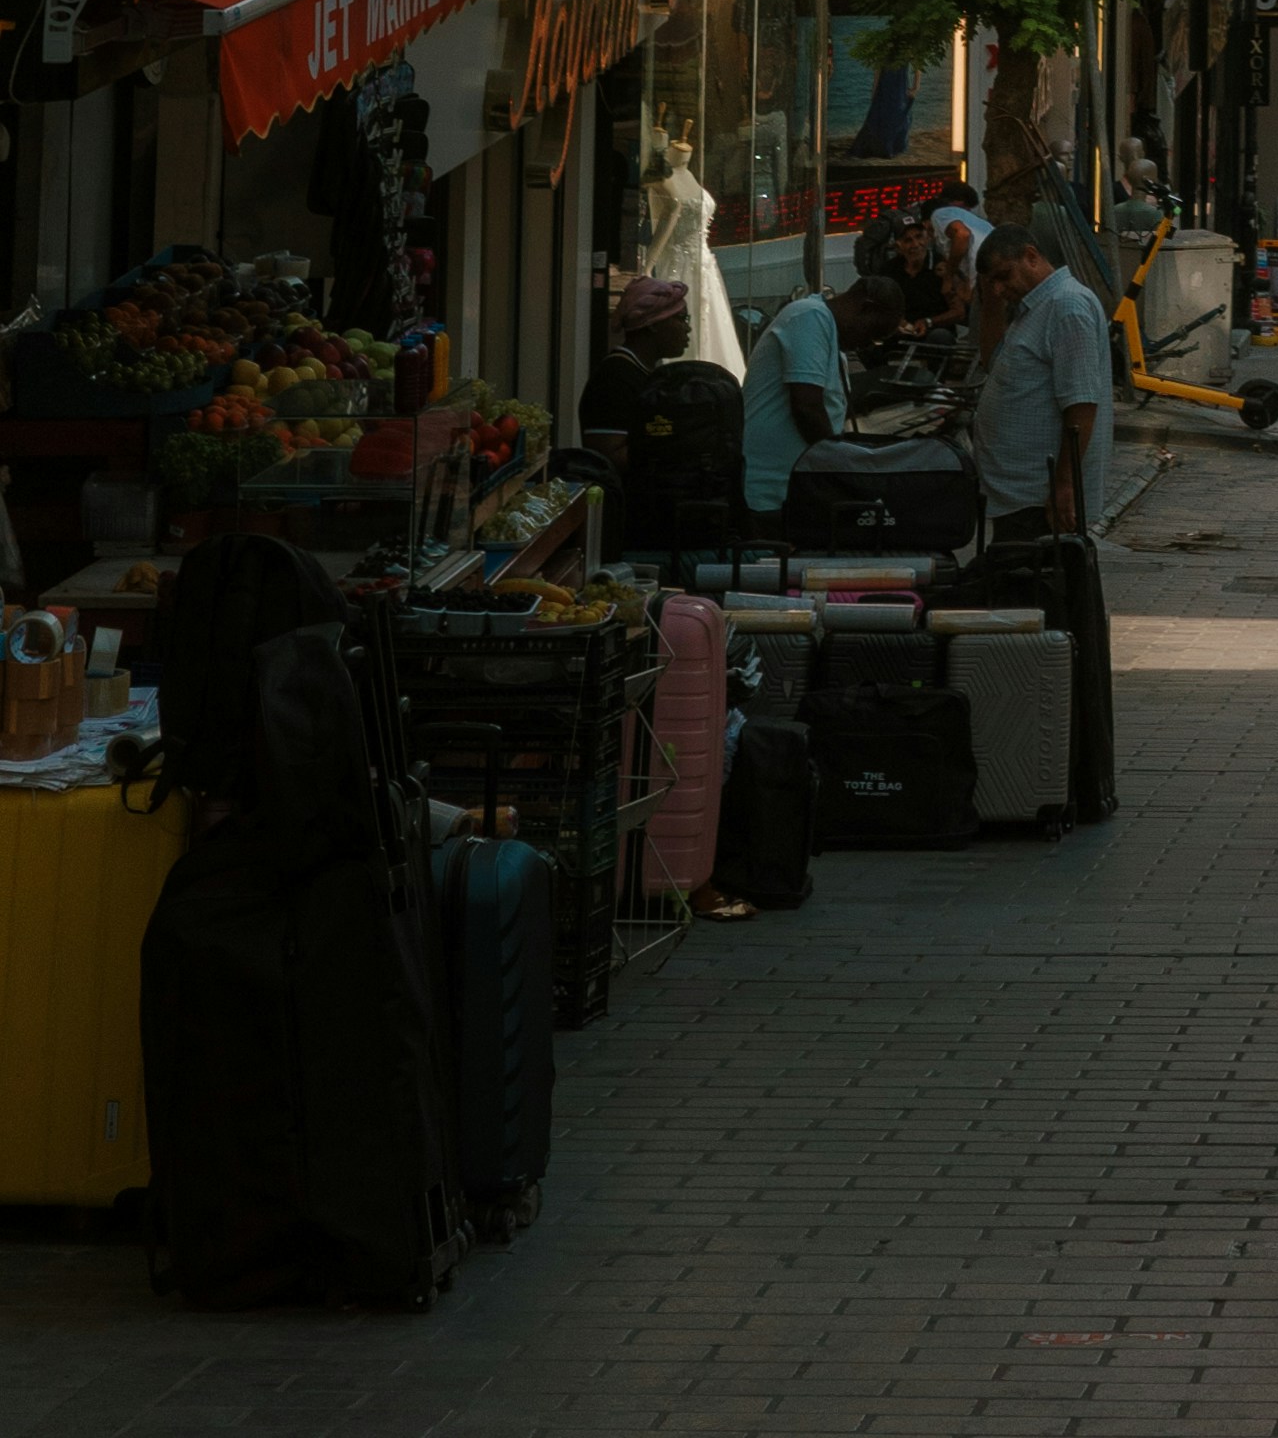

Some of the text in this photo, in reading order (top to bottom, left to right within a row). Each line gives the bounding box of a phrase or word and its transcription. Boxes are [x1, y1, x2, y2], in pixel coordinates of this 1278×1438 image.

[862, 771, 886, 781] THE
[843, 780, 903, 791] TOTE BAG
